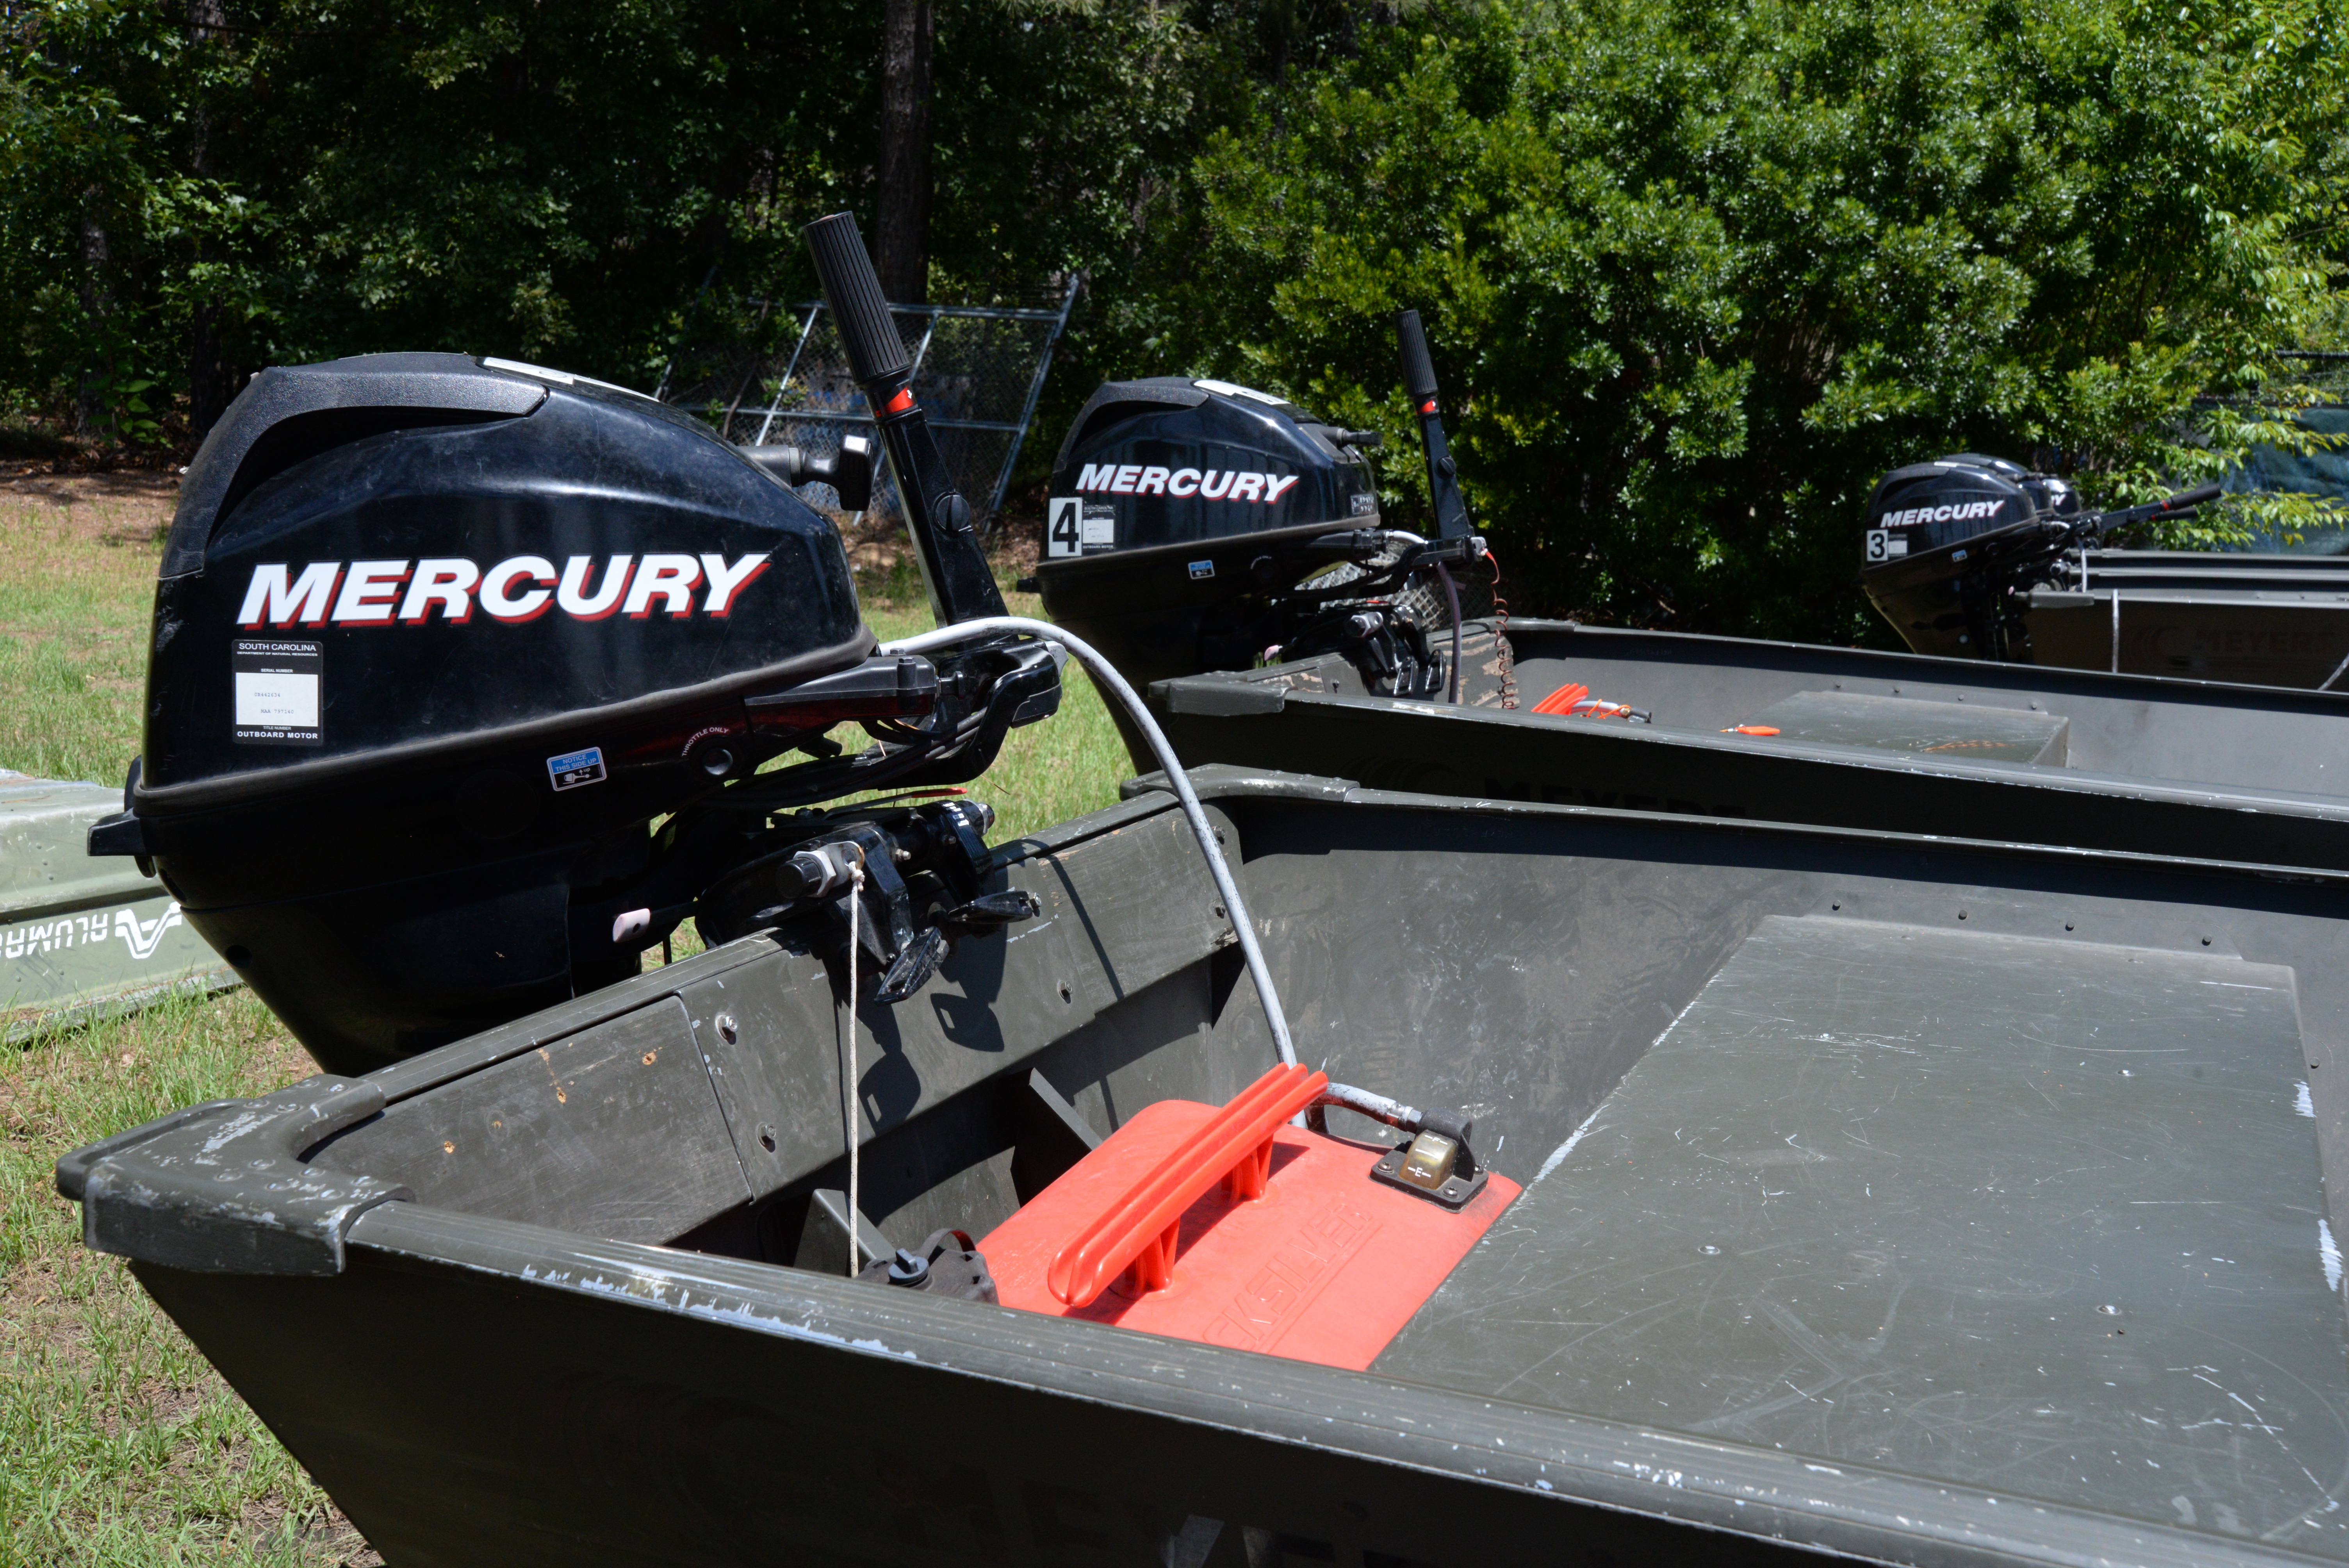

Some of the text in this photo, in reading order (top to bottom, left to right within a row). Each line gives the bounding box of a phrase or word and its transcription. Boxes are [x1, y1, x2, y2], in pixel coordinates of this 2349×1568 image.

[1076, 464, 1299, 504] MERCURY
[1052, 502, 1079, 553] 4
[1880, 500, 2005, 528] MERCURY
[1870, 533, 1885, 559] 3
[236, 554, 771, 630] MERCURY
[562, 754, 587, 764] NOTICE
[681, 728, 709, 757] THROTTLE
[0, 913, 108, 959] ALUMA
